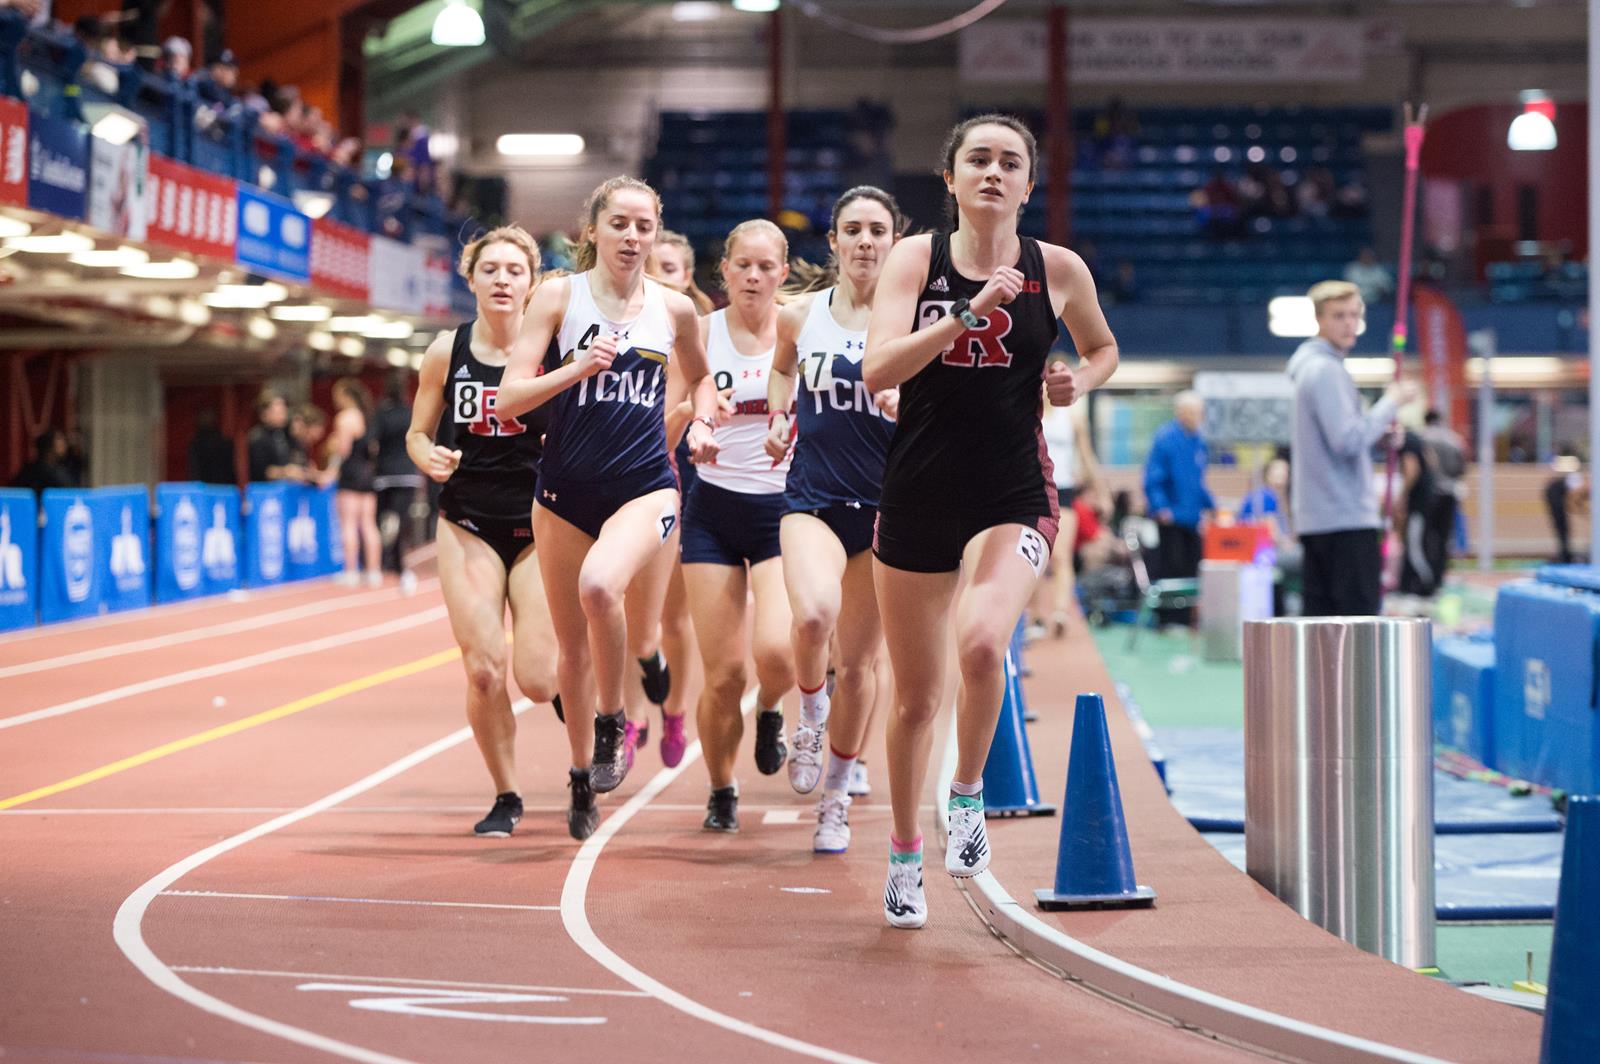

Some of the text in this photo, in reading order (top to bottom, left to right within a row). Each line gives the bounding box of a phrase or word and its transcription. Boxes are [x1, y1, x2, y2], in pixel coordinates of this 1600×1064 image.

[577, 324, 600, 350] 4
[942, 306, 1013, 367] R
[811, 352, 827, 388] 7
[458, 385, 477, 419] 8
[661, 515, 675, 540] 4
[1021, 532, 1042, 567] 3
